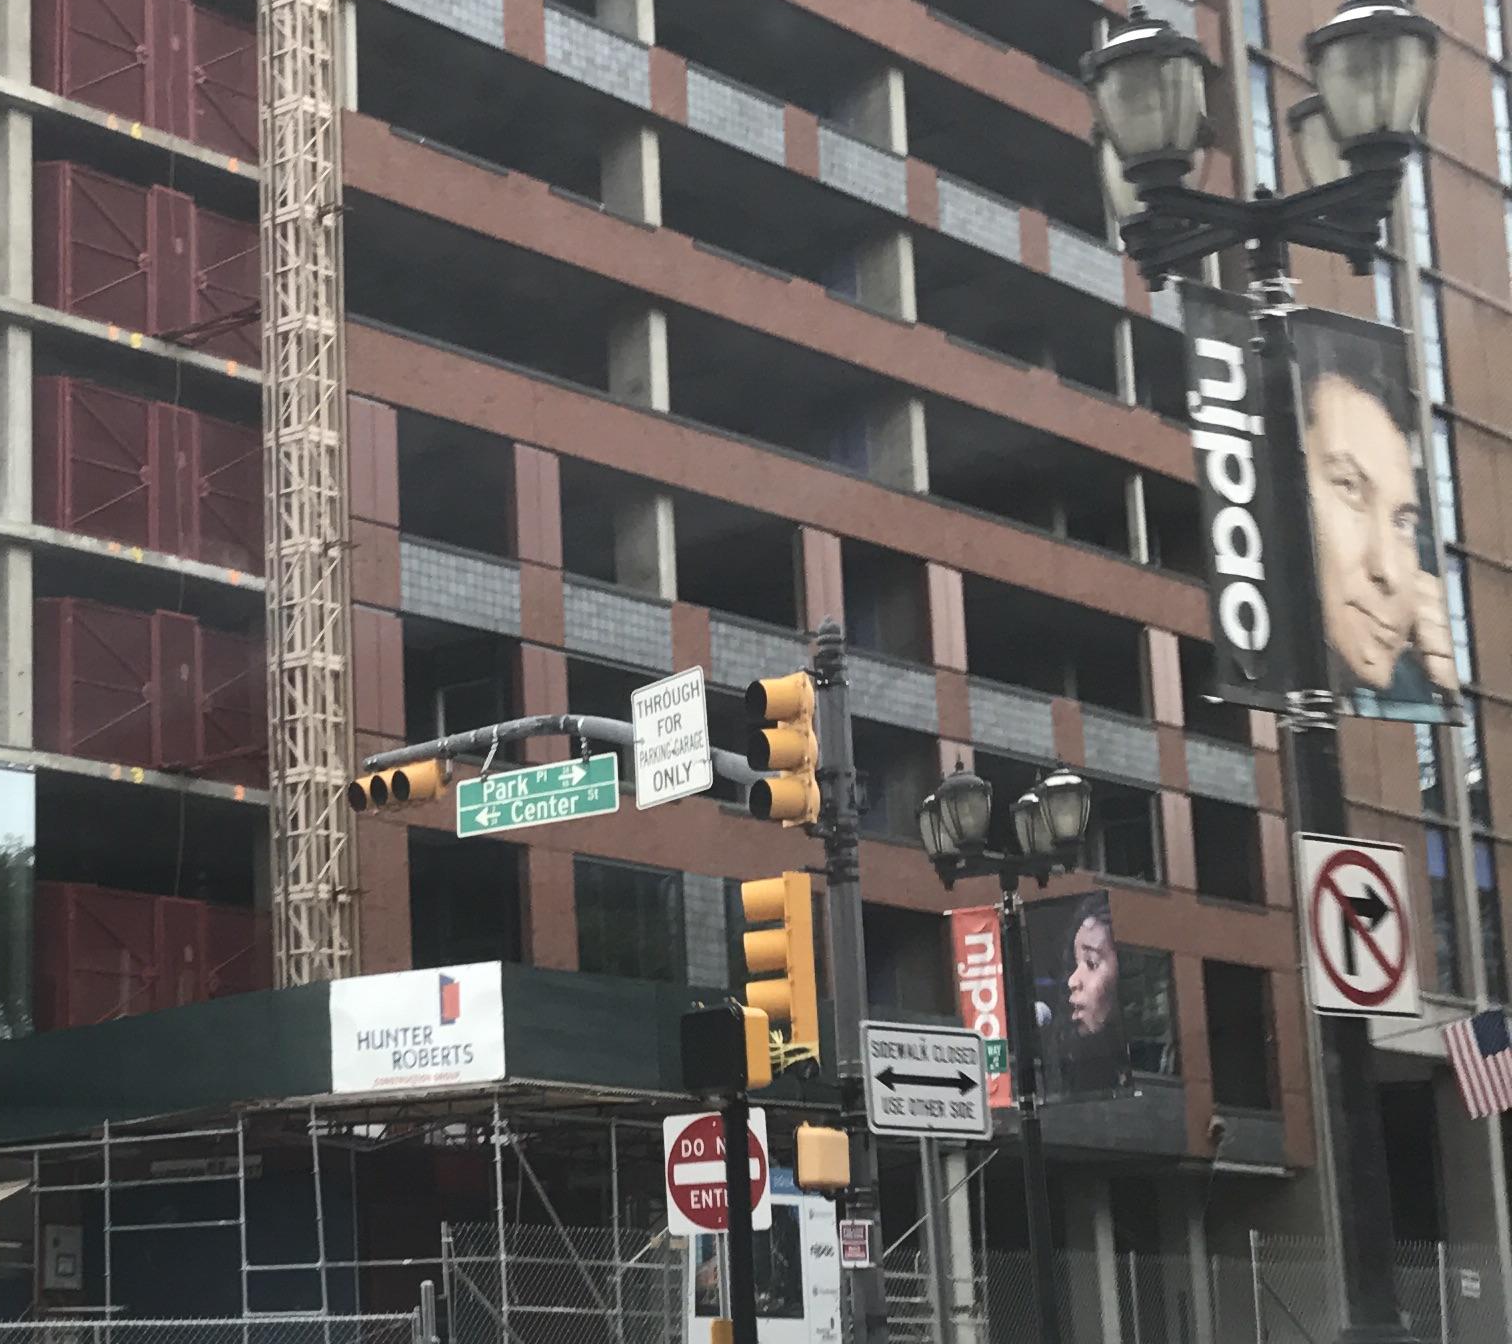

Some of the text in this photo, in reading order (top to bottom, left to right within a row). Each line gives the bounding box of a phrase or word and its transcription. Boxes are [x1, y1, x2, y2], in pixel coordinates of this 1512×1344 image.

[1185, 337, 1272, 651] njpac
[636, 679, 700, 718] THROUGH
[657, 713, 682, 736] FOR
[639, 730, 704, 768] PARKING GARAGE
[483, 774, 529, 803] Park
[536, 770, 548, 783] Pl
[653, 760, 692, 792] ONLY
[511, 787, 599, 823] Center St
[957, 932, 1003, 1080] njpa
[357, 1025, 434, 1051] HUNTER
[988, 1044, 1001, 1056] WAY
[392, 1043, 474, 1071] ROBERTS
[871, 1040, 929, 1061] SIDEWALK
[932, 1044, 977, 1065] CLOSED
[880, 1096, 976, 1120] USE OTHER SIDE
[681, 1138, 704, 1157] DO
[690, 1188, 729, 1209] ENT
